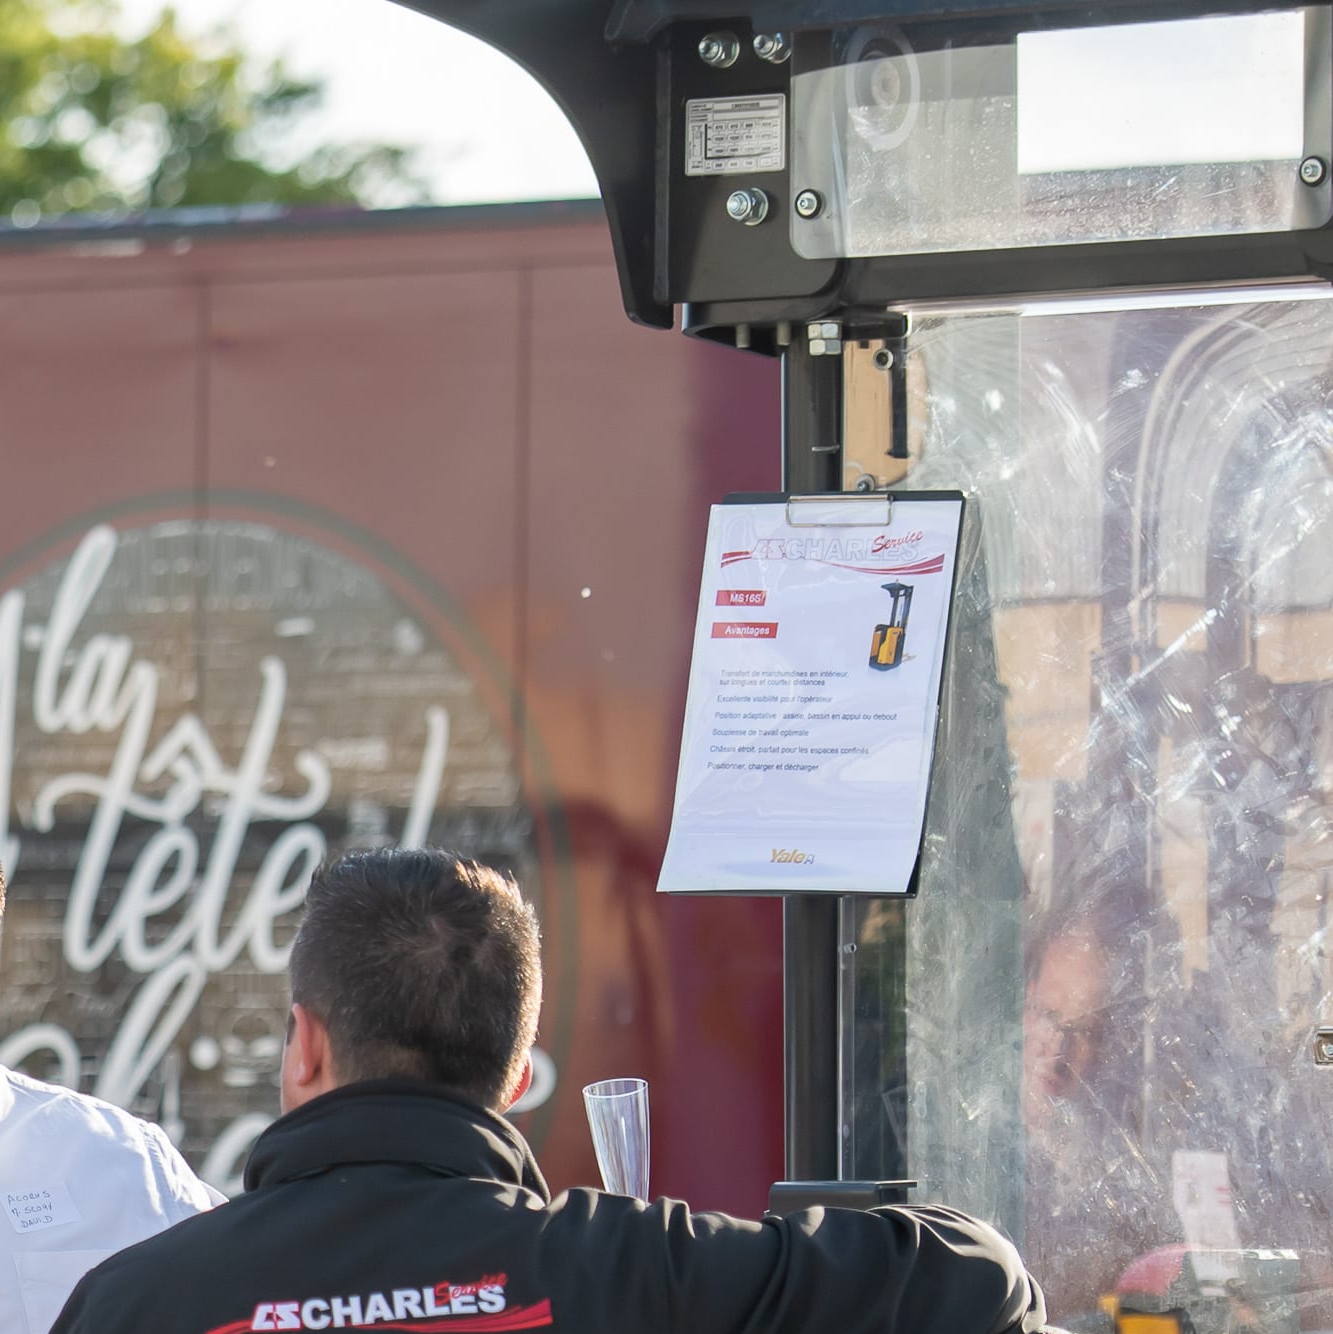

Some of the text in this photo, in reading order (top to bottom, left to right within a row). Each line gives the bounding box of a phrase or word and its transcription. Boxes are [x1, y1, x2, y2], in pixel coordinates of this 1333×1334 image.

[871, 530, 924, 554] Service
[724, 625, 770, 637] Avantages
[752, 670, 760, 678] de
[748, 729, 757, 737] de
[781, 747, 797, 756] pour
[810, 747, 839, 756] espaces
[748, 761, 774, 772] charger
[776, 762, 782, 770] et
[770, 848, 806, 864] Yale
